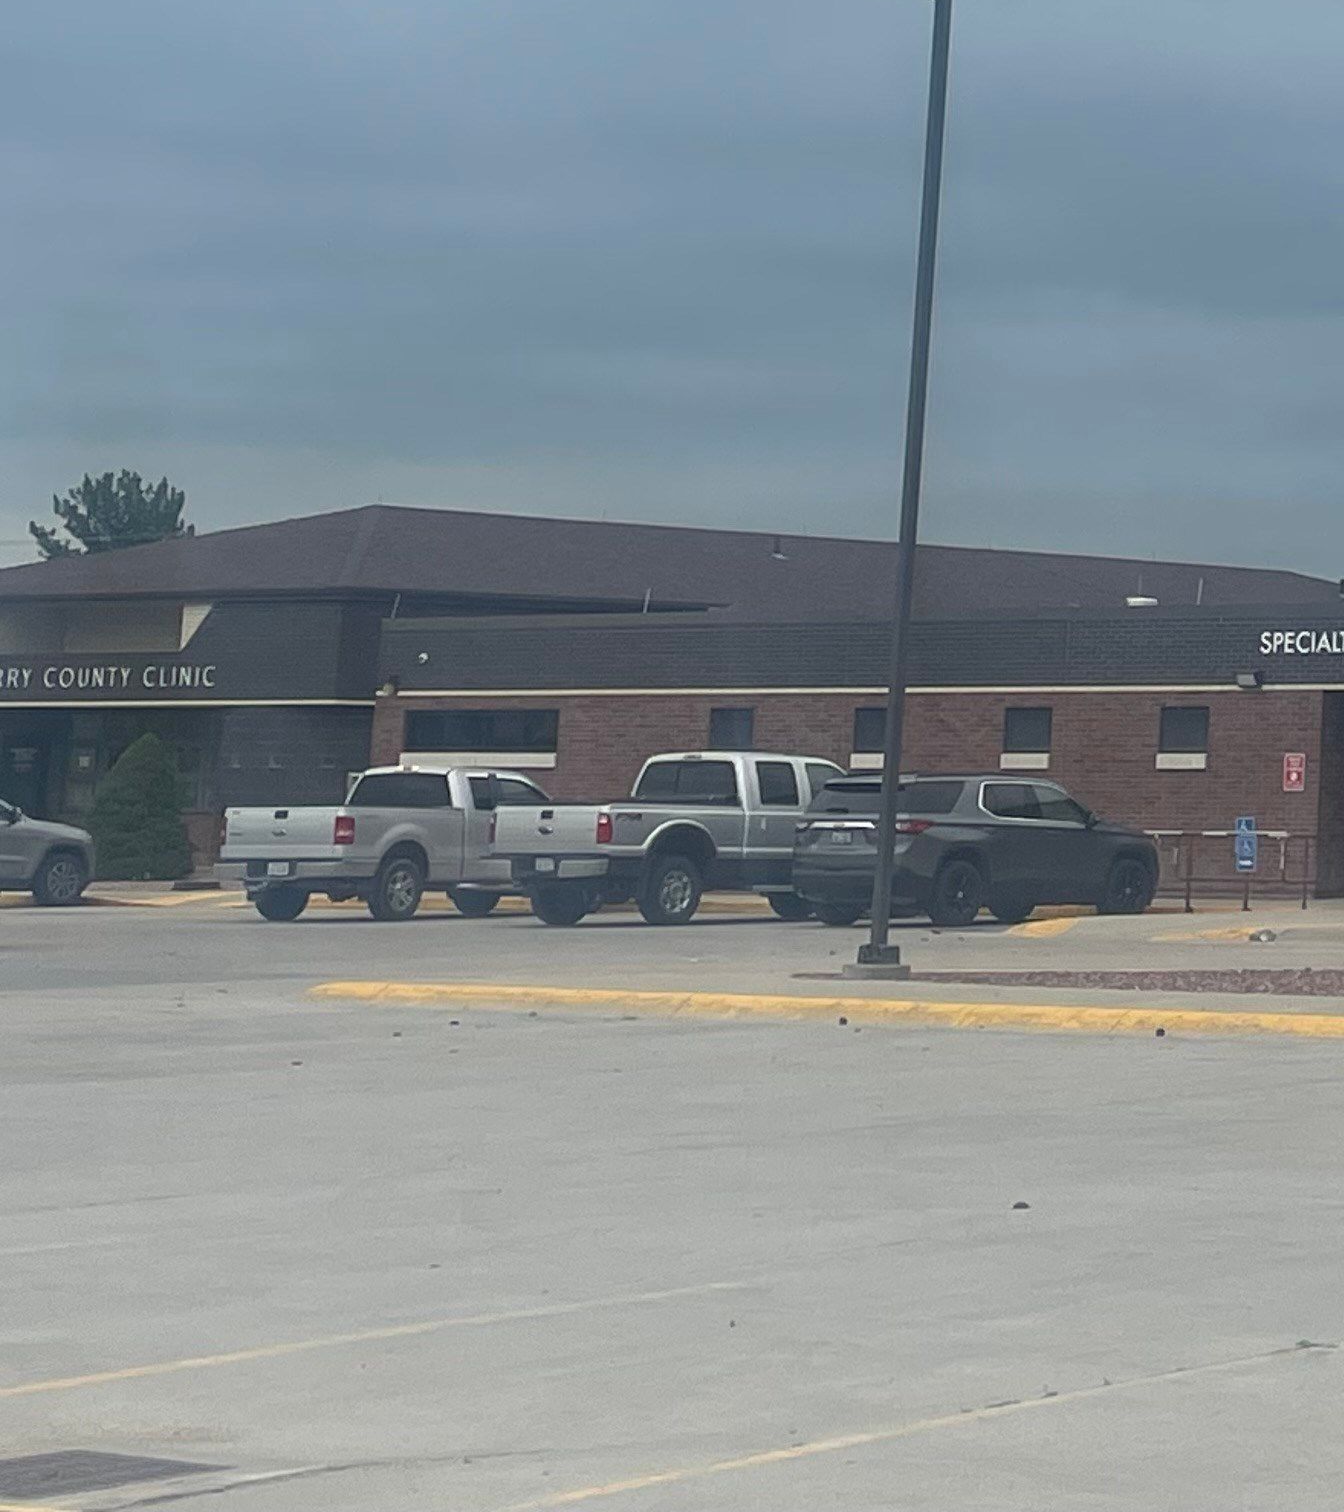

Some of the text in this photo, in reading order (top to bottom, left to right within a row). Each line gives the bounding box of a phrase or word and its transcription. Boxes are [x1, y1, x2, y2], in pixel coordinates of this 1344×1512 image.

[0, 666, 216, 688] RY COUNTY CLINIC
